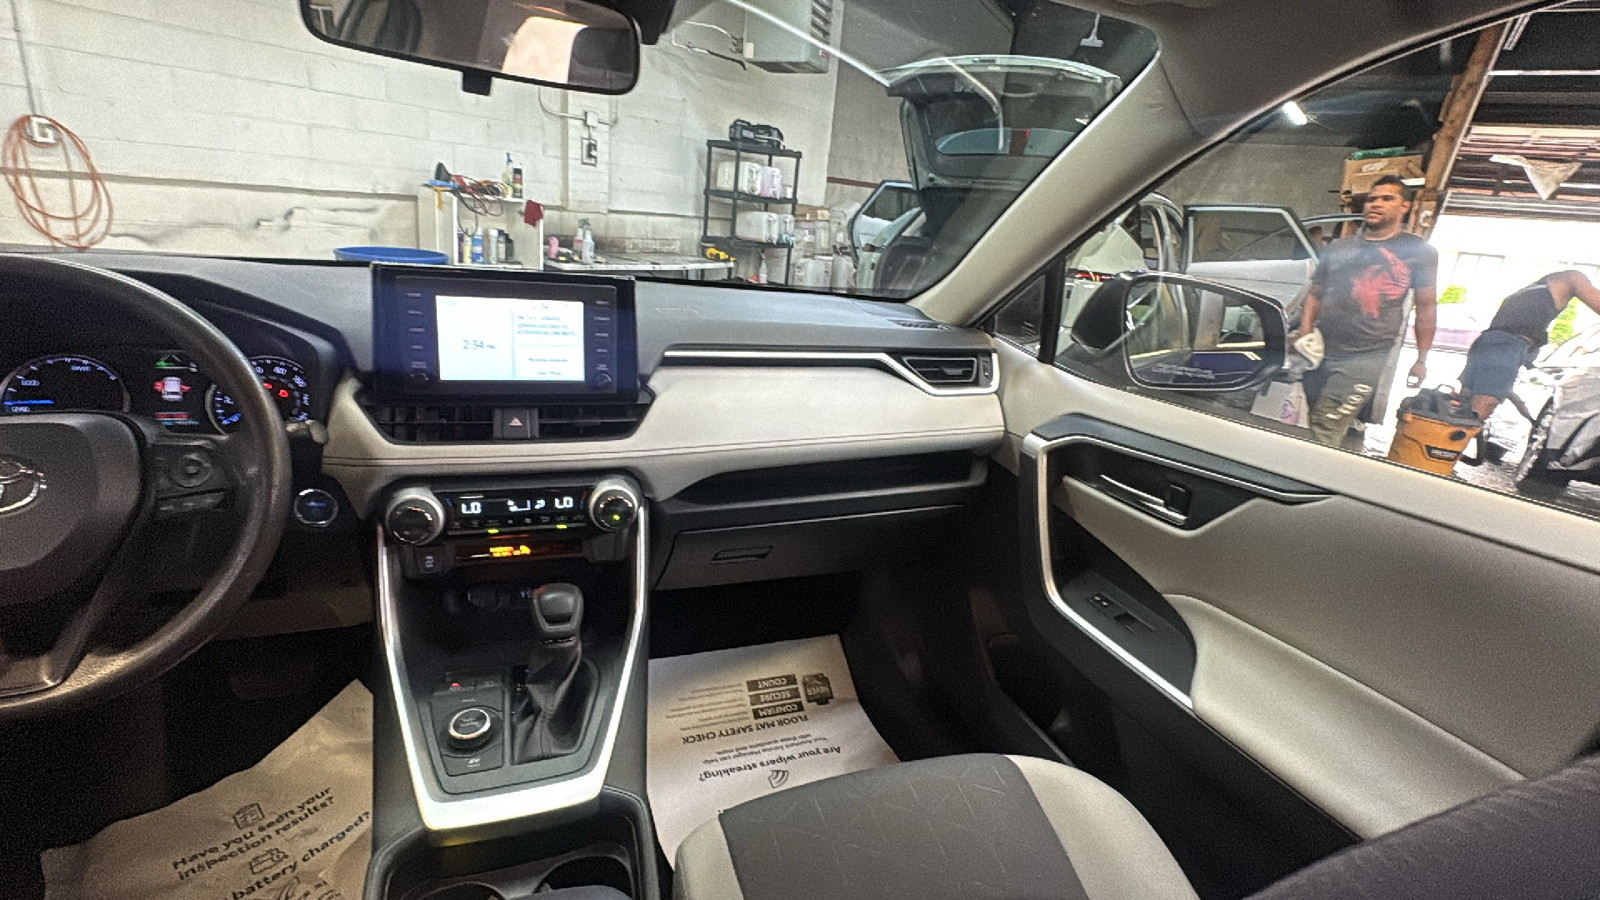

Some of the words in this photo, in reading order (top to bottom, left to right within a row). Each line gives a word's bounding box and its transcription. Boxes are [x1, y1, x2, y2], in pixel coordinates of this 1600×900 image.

[757, 677, 788, 690] COUNT
[759, 691, 792, 704] SECURE
[758, 703, 798, 717] CONFIRM
[755, 721, 775, 732] MAT
[776, 714, 809, 727] FLOOR
[682, 731, 716, 746] CHECK
[718, 725, 754, 739] SAFETY
[797, 749, 822, 760] your
[823, 746, 841, 756] Are
[759, 755, 796, 769] wipers
[699, 764, 758, 782] streaking?
[172, 845, 219, 870] Have
[222, 831, 255, 851] you
[297, 787, 331, 812] your
[177, 833, 273, 881] inspection
[275, 796, 334, 836] results?
[231, 861, 298, 900] battery
[301, 811, 371, 863] charged?
